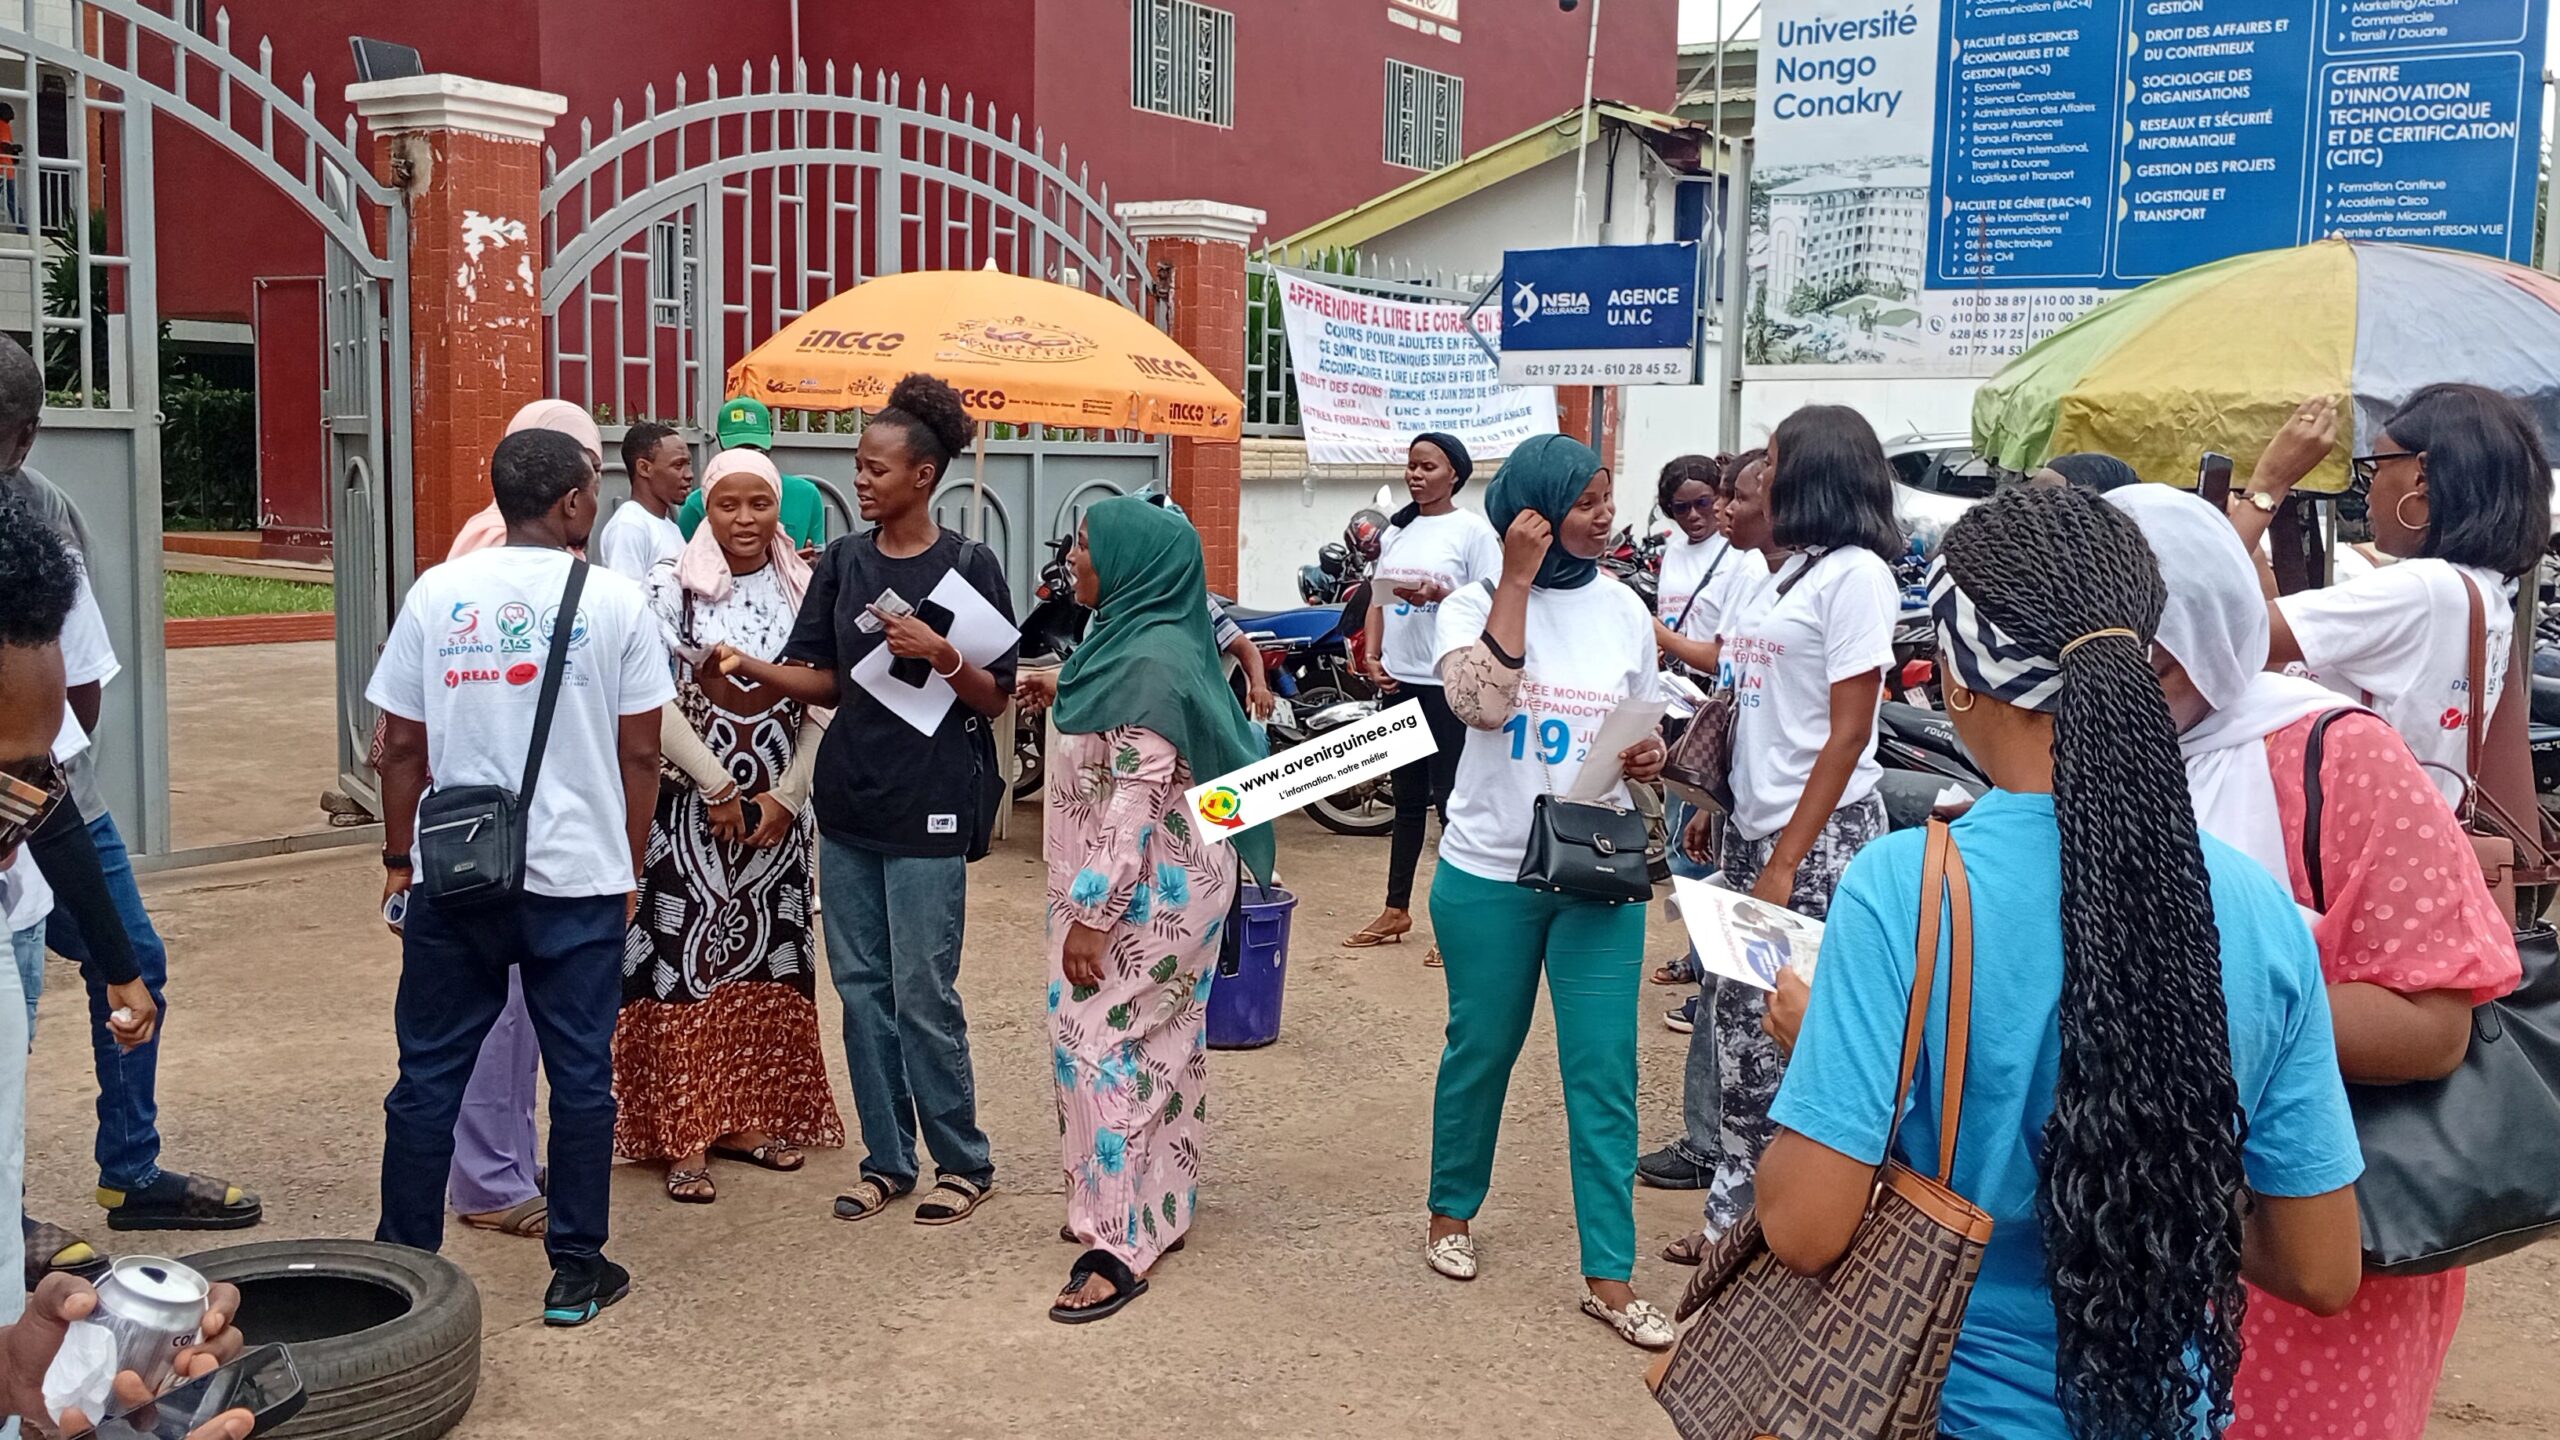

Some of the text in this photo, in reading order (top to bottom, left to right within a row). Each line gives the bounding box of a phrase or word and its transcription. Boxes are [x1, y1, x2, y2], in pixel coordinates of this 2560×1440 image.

[1975, 3, 2050, 17] Communication
[2147, 0, 2203, 15] GESTION
[1778, 4, 1917, 48] Université
[2352, 12, 2434, 28] Commerciale
[2145, 19, 2289, 42] DROIT DES AFFAIRES ET
[2351, 26, 2448, 43] Transit / Douane
[1963, 29, 2079, 49] FACULTÉ DES SCIENCES
[1962, 47, 2070, 65] ÉCONOMIQUES ET DE
[2144, 41, 2254, 61] DU CONTENTIEUX
[1776, 56, 1876, 85] Nongo
[1961, 64, 2051, 81] GESTION (BAC+3)
[2332, 66, 2400, 85] CENTRE
[2142, 69, 2252, 88] SOCIOLOGIE DES
[1973, 91, 2076, 106] Sciences Comptables
[2141, 86, 2250, 104] ORGANISATIONS
[2331, 82, 2470, 105] D'INNOVATION
[1774, 86, 1903, 120] Conakry
[1973, 103, 2096, 118] Administration des Affaires
[2140, 108, 2272, 132] RESEAUX ET SÉCURITÉ
[2329, 102, 2491, 125] TECHNOLOGIQUE
[1973, 118, 2063, 132] Banque Assurances
[1973, 132, 2053, 146] Banque Finances
[2139, 133, 2236, 150] INFORMATIQUE
[2328, 122, 2515, 146] ET DE CERTIFICATION
[1971, 147, 2025, 158] Commerce
[2326, 148, 2383, 170] (CITC)
[1971, 158, 2049, 170] Transit & Douane
[2137, 158, 2275, 177] GESTION DES PROJETS
[1971, 170, 2075, 185] Logistique et Transport
[2339, 180, 2446, 193] Formation Continue
[1955, 196, 2092, 211] FACULTE DE GÉNIE (BAC+4)
[2135, 188, 2226, 204] LOGISTIQUE ET
[2337, 195, 2429, 208] Académie Cisco
[1998, 211, 2069, 224] Informatique et
[2134, 207, 2206, 222] TRANSPORT
[2336, 210, 2447, 223] Académie Microsoft
[2433, 224, 2477, 236] PERSON
[2480, 224, 2504, 235] VUE
[1995, 239, 2053, 250] Electronique
[1541, 292, 1591, 308] NSIA
[1607, 287, 1679, 306] AGENCE
[1952, 296, 2027, 307] 610 00 38 89
[2034, 295, 2056, 306] 610
[2060, 295, 2074, 305] 00
[2078, 295, 2093, 305] 38
[1289, 283, 1493, 332] APPRENDRE A LIRE LE CORA EN
[1541, 306, 1590, 316] ASSURANCES
[1607, 309, 1653, 326] U.N.C
[1951, 312, 2025, 323] 610 00 38 87
[2033, 312, 2055, 322] 610
[2058, 312, 2074, 322] 00
[1325, 322, 1460, 350] COURS POUR ADULTES EN
[1950, 329, 2024, 339] 628 45 17 25
[1319, 340, 1331, 352] CE
[1333, 343, 1357, 358] SONT
[1360, 347, 1376, 361] DES
[1379, 350, 1431, 367] TECHNIQUES
[1433, 353, 1466, 366] SIMPLES
[1948, 345, 2022, 355] 621 77 34 53
[1525, 365, 1544, 375] 621
[1548, 365, 1561, 375] 97
[1564, 365, 1577, 375] 23
[1580, 364, 1594, 375] 24
[1604, 364, 1625, 375] 610
[1629, 364, 1642, 374] 28
[1646, 363, 1660, 374] 45
[1329, 381, 1348, 394] DES
[1351, 383, 1383, 398] COURS
[1395, 407, 1420, 416] UNC
[439, 644, 493, 658] DREPANO
[461, 670, 500, 681] READ
[1503, 714, 1569, 764] 19
[1924, 726, 1953, 741] FOUTA
